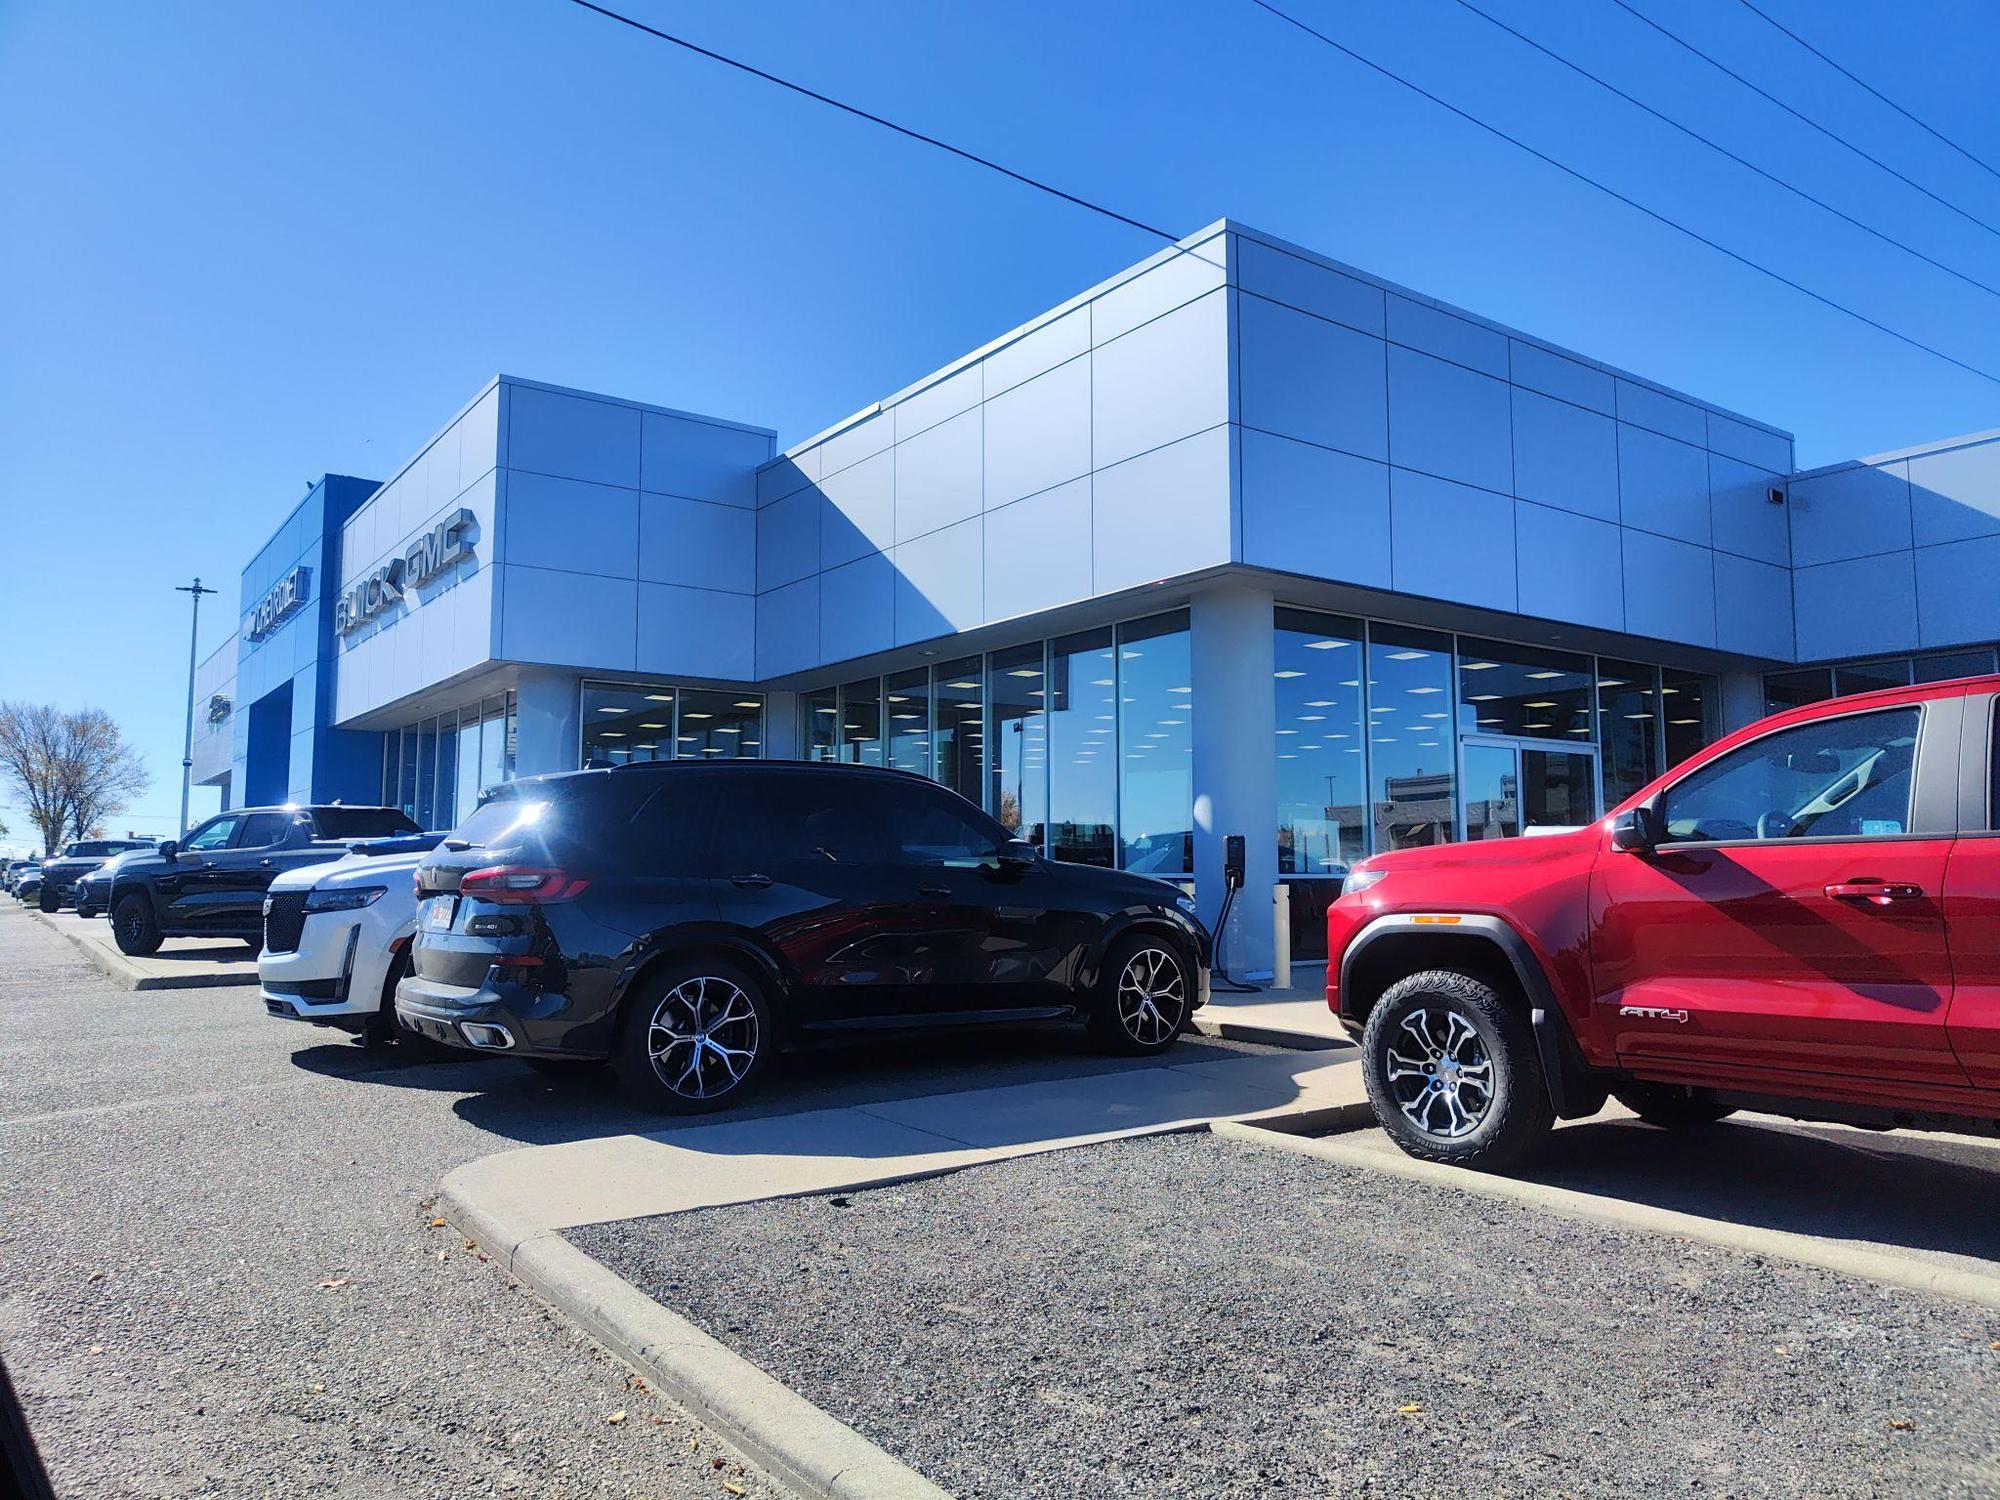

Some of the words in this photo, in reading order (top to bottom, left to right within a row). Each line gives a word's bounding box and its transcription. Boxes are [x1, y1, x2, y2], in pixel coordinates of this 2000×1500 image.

[335, 558, 406, 636] BUICK
[405, 508, 481, 589] GMC
[1620, 1006, 1689, 1024] AT4
